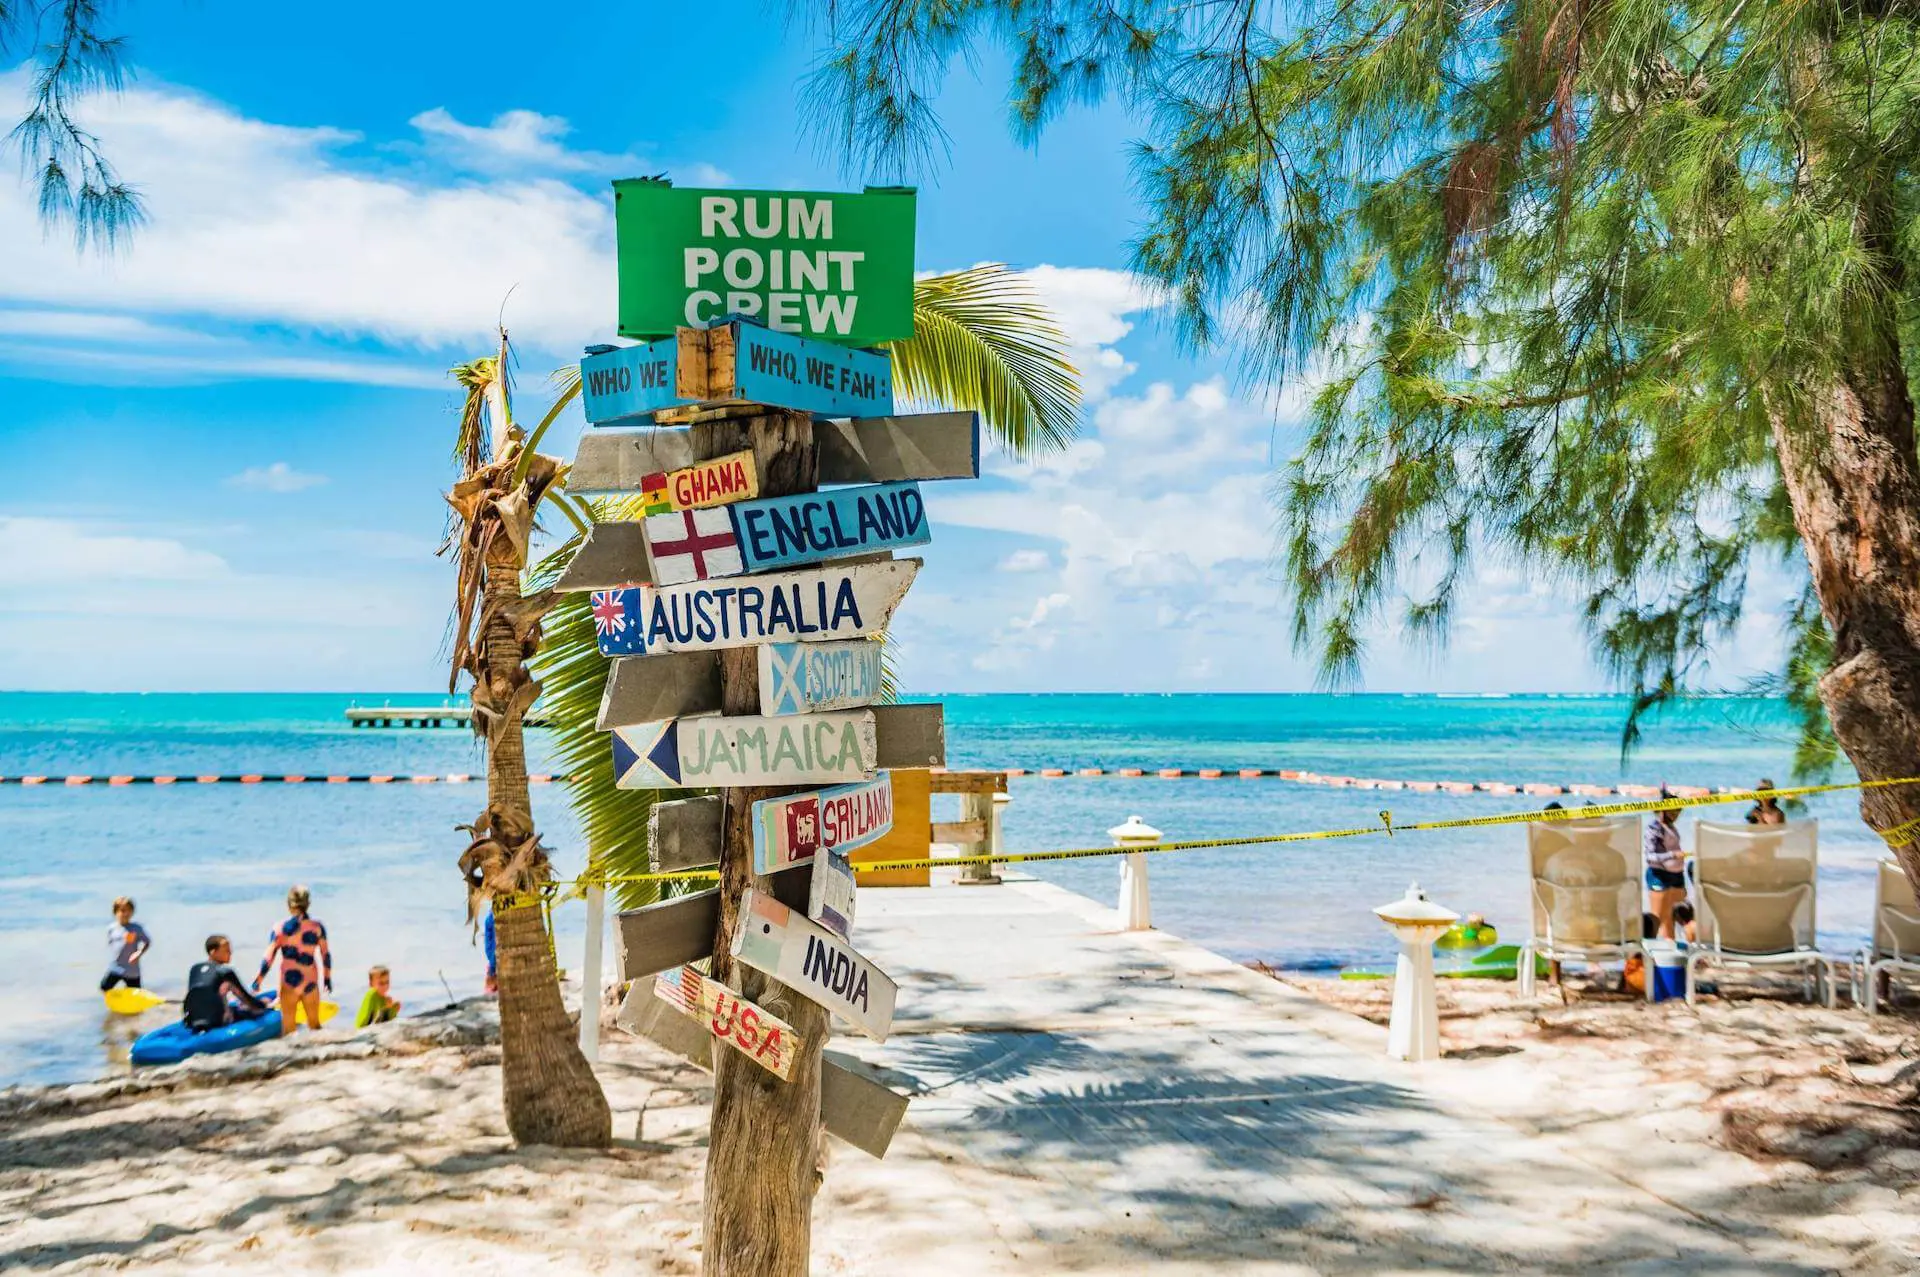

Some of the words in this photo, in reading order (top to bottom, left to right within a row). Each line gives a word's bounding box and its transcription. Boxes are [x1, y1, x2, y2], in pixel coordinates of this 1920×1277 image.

[700, 196, 834, 240] RUM
[684, 248, 865, 291] POINT
[588, 366, 632, 397] WHO
[639, 360, 668, 389] WE
[806, 357, 835, 390] WE
[675, 461, 749, 506] GHANA
[744, 489, 924, 561] ENGLAND
[647, 577, 864, 645] AUSTRALIA
[682, 720, 865, 776] JAMAICA
[823, 796, 855, 849] SRI
[803, 934, 869, 1014] INDIA
[712, 992, 782, 1068] USA
